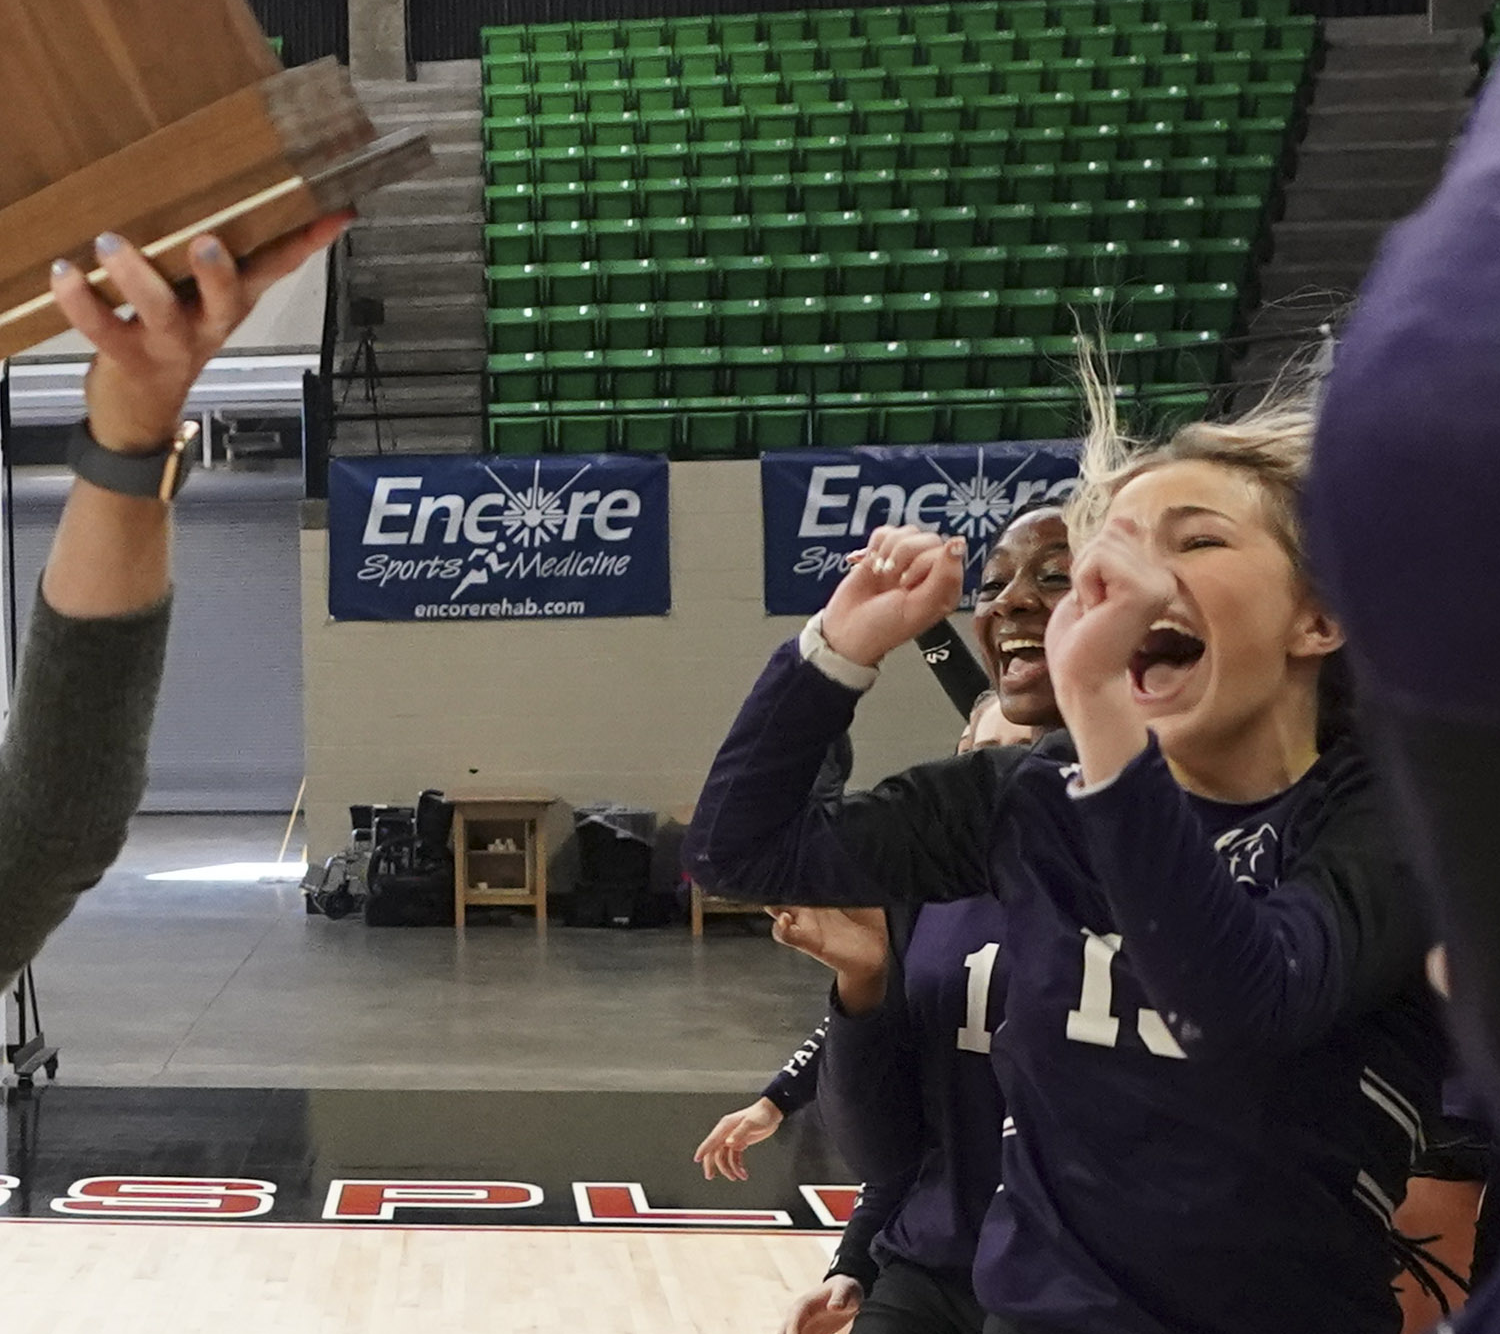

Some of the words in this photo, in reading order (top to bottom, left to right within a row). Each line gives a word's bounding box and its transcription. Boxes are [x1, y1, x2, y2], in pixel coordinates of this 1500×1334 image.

[357, 553, 464, 587] Sports
[505, 550, 632, 579] Medicine
[414, 597, 586, 618] encorerehab.com
[1066, 926, 1188, 1060] 1
